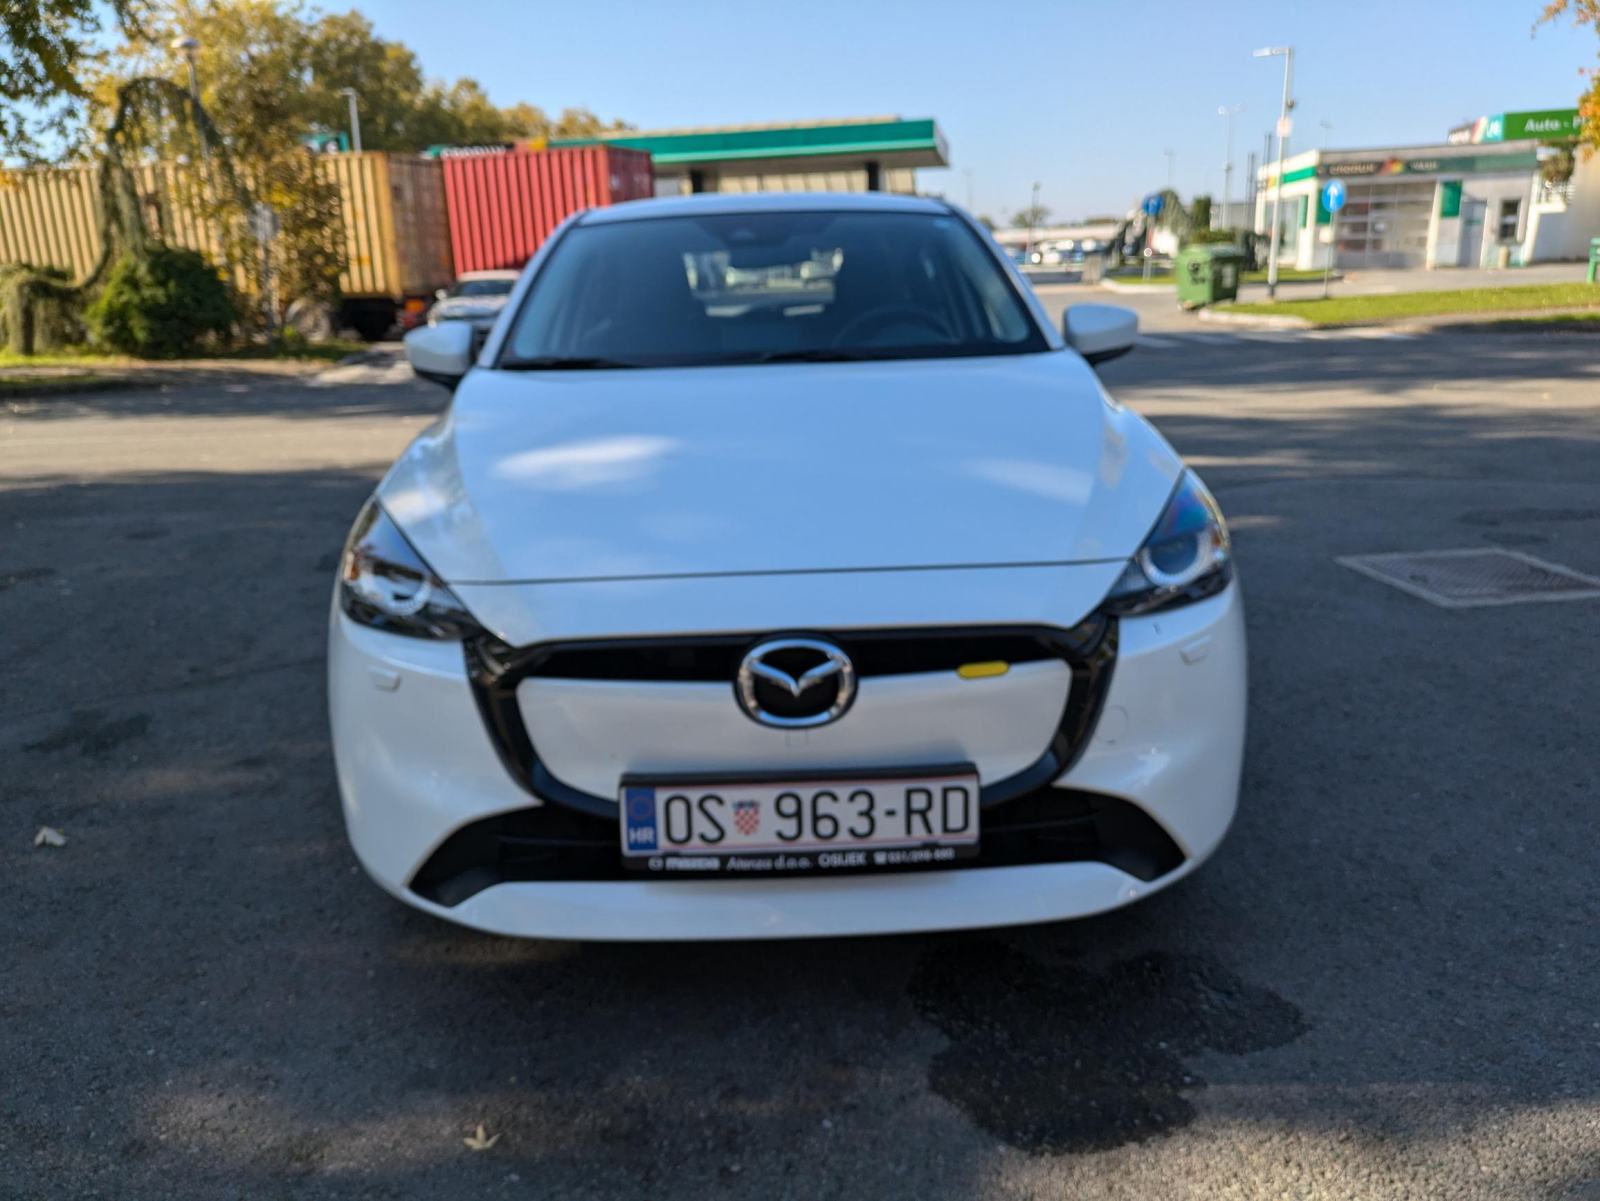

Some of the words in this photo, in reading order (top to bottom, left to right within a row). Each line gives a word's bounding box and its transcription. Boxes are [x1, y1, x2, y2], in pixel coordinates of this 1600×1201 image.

[1524, 117, 1561, 133] Auto
[664, 793, 726, 845] OS
[774, 786, 970, 842] 963-RD
[629, 826, 656, 844] HR
[818, 851, 867, 868] OSIJEK
